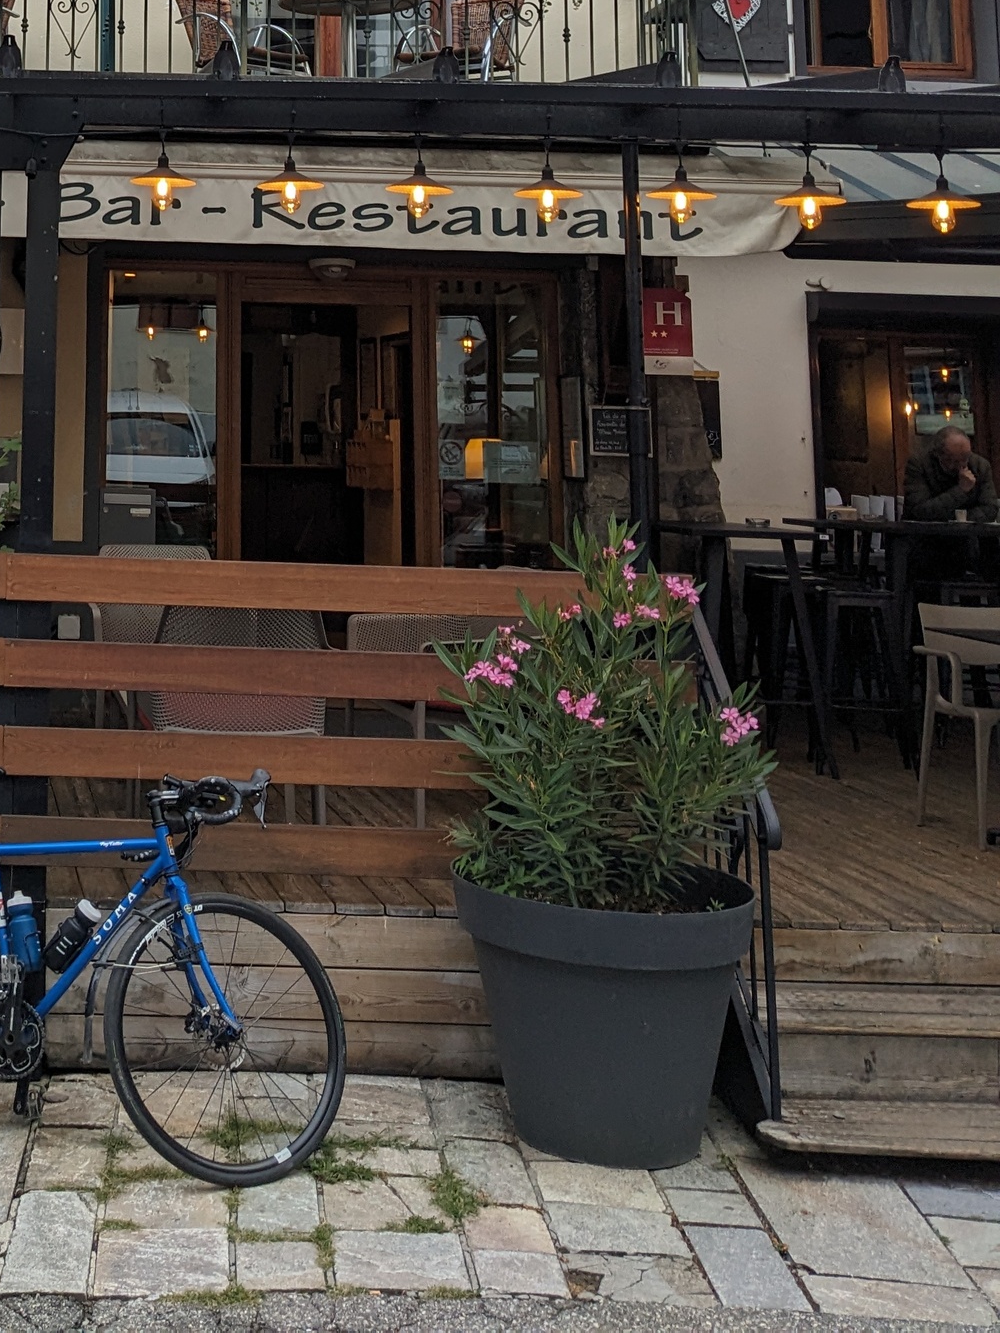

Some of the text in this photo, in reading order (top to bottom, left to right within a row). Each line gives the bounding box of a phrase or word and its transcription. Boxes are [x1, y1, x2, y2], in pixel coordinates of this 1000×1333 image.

[59, 182, 181, 226] Bar
[655, 301, 684, 326] H
[93, 892, 137, 945] SOMA
